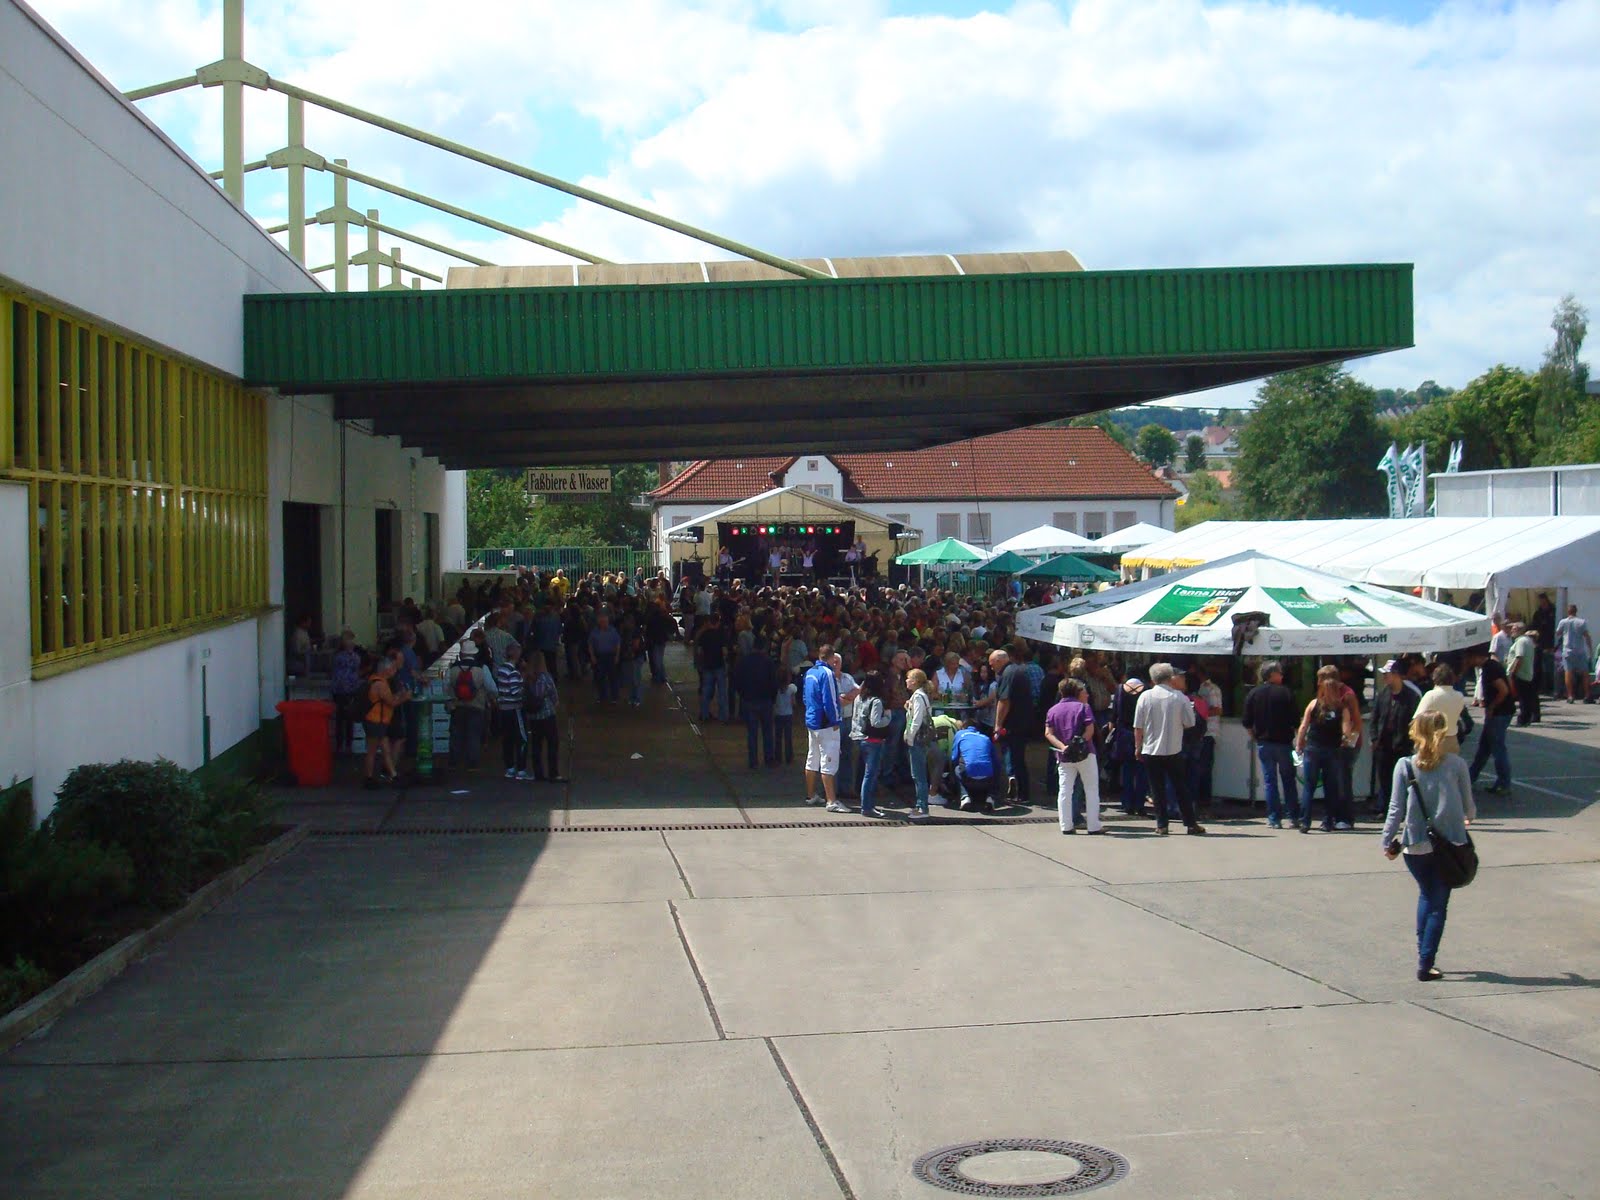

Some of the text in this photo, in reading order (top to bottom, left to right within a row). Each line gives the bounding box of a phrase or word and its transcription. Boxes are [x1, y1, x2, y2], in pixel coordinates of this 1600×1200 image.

[530, 473, 609, 490] Faßbiere & Wasser
[1154, 632, 1199, 643] Bischoff
[1343, 633, 1388, 644] Bischoff
